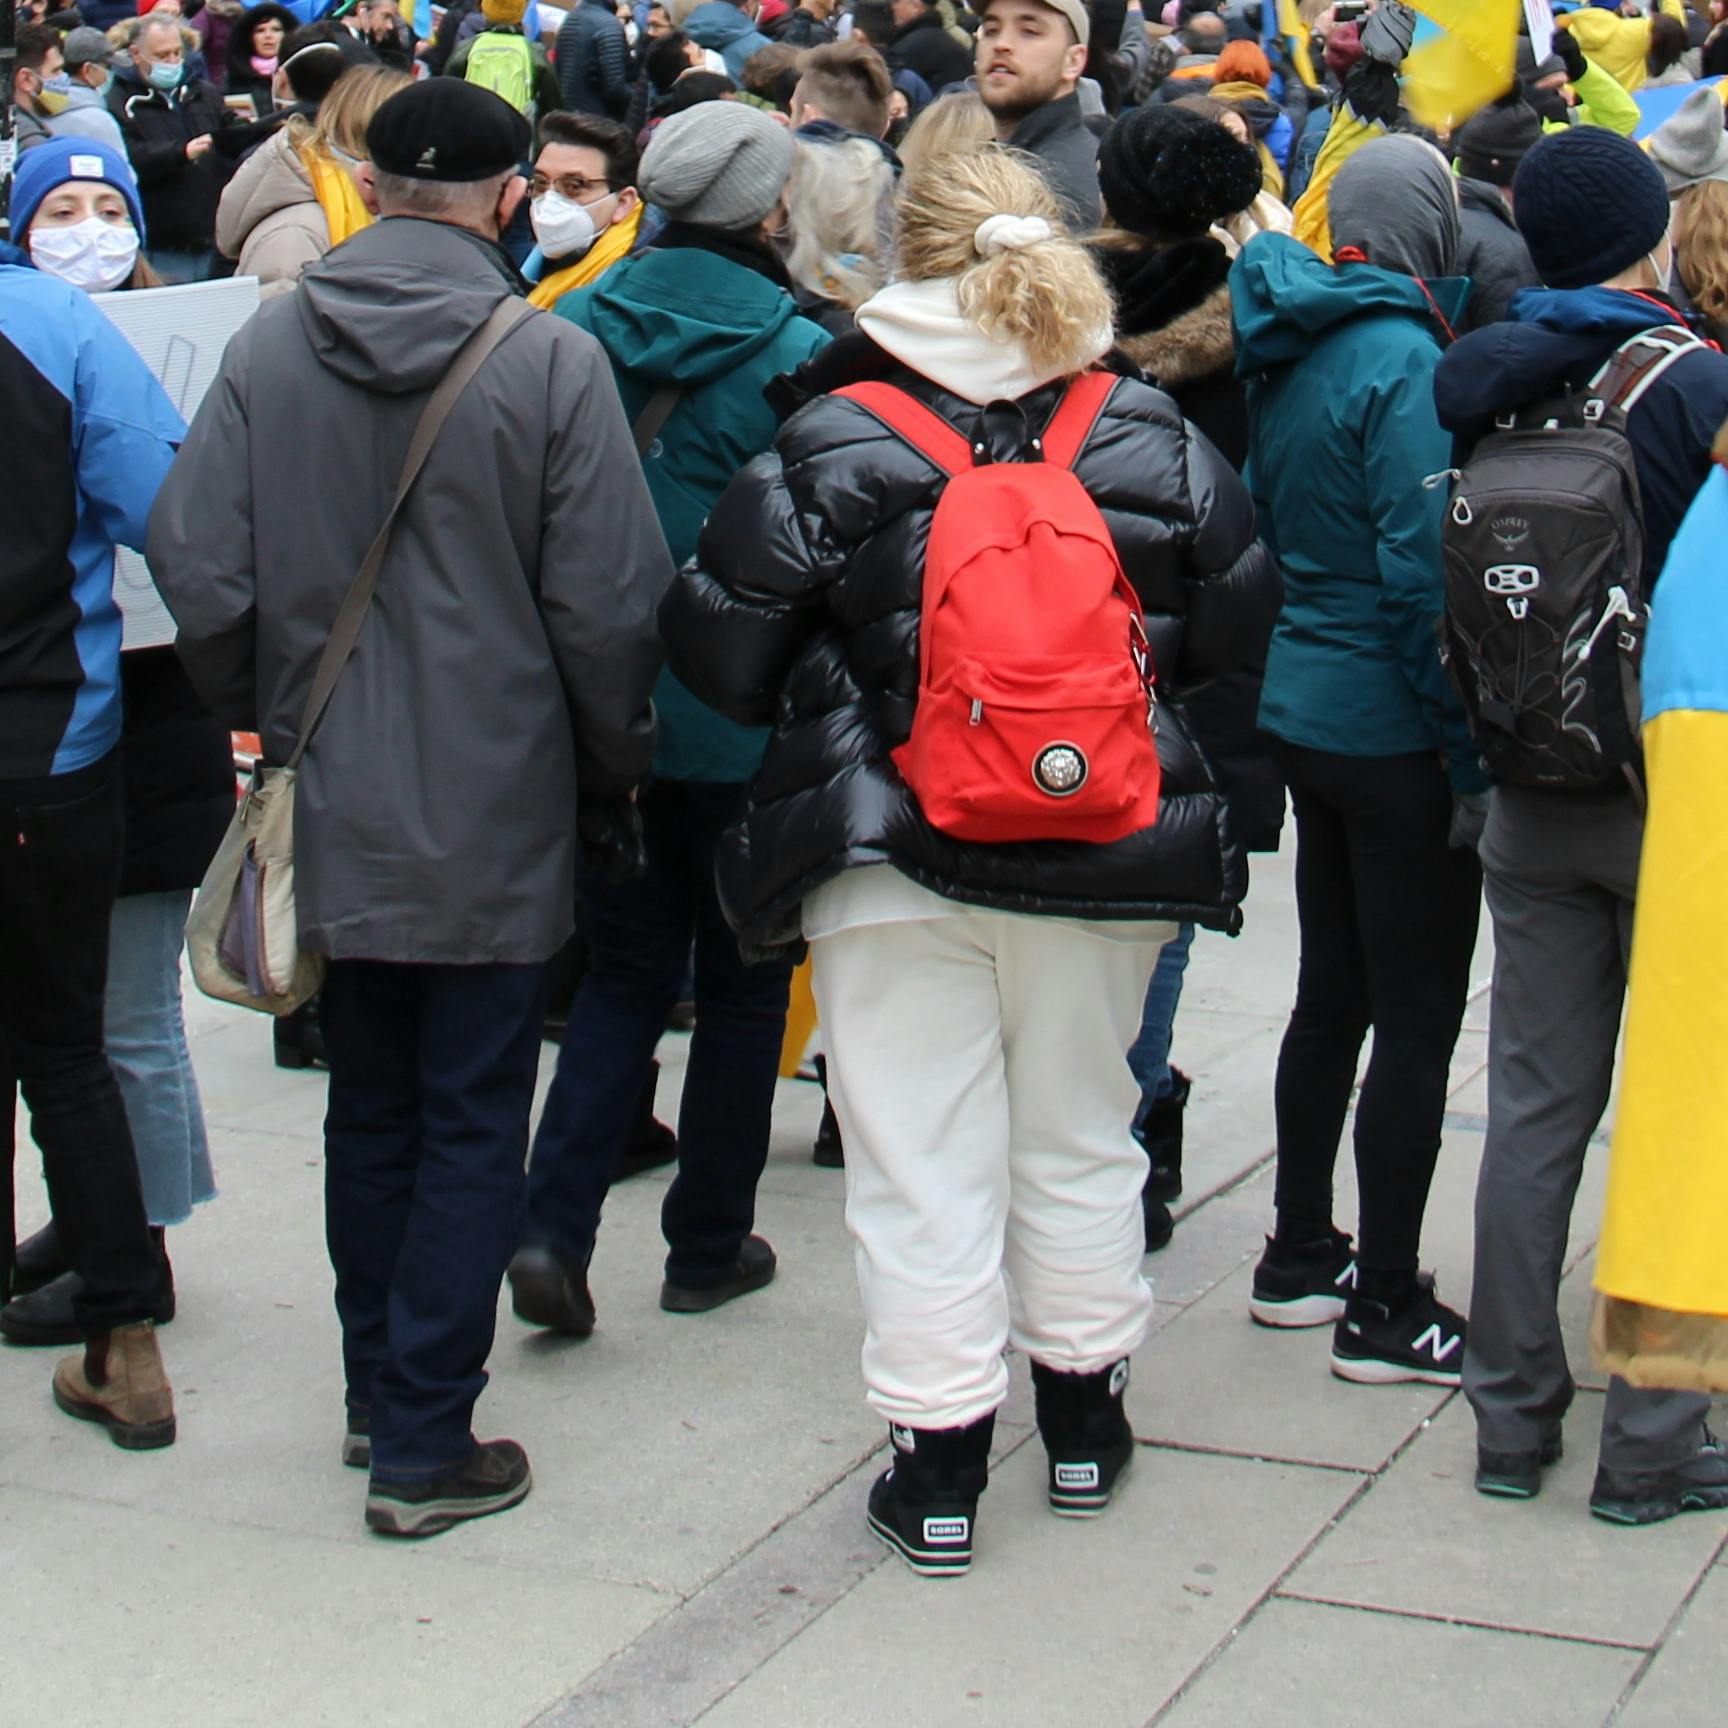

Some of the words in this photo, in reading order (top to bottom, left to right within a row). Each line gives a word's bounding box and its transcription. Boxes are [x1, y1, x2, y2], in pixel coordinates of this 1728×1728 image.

[1490, 516, 1530, 531] OSPREY
[1060, 1470, 1092, 1481] SOREL
[929, 1524, 963, 1535] SOREL
